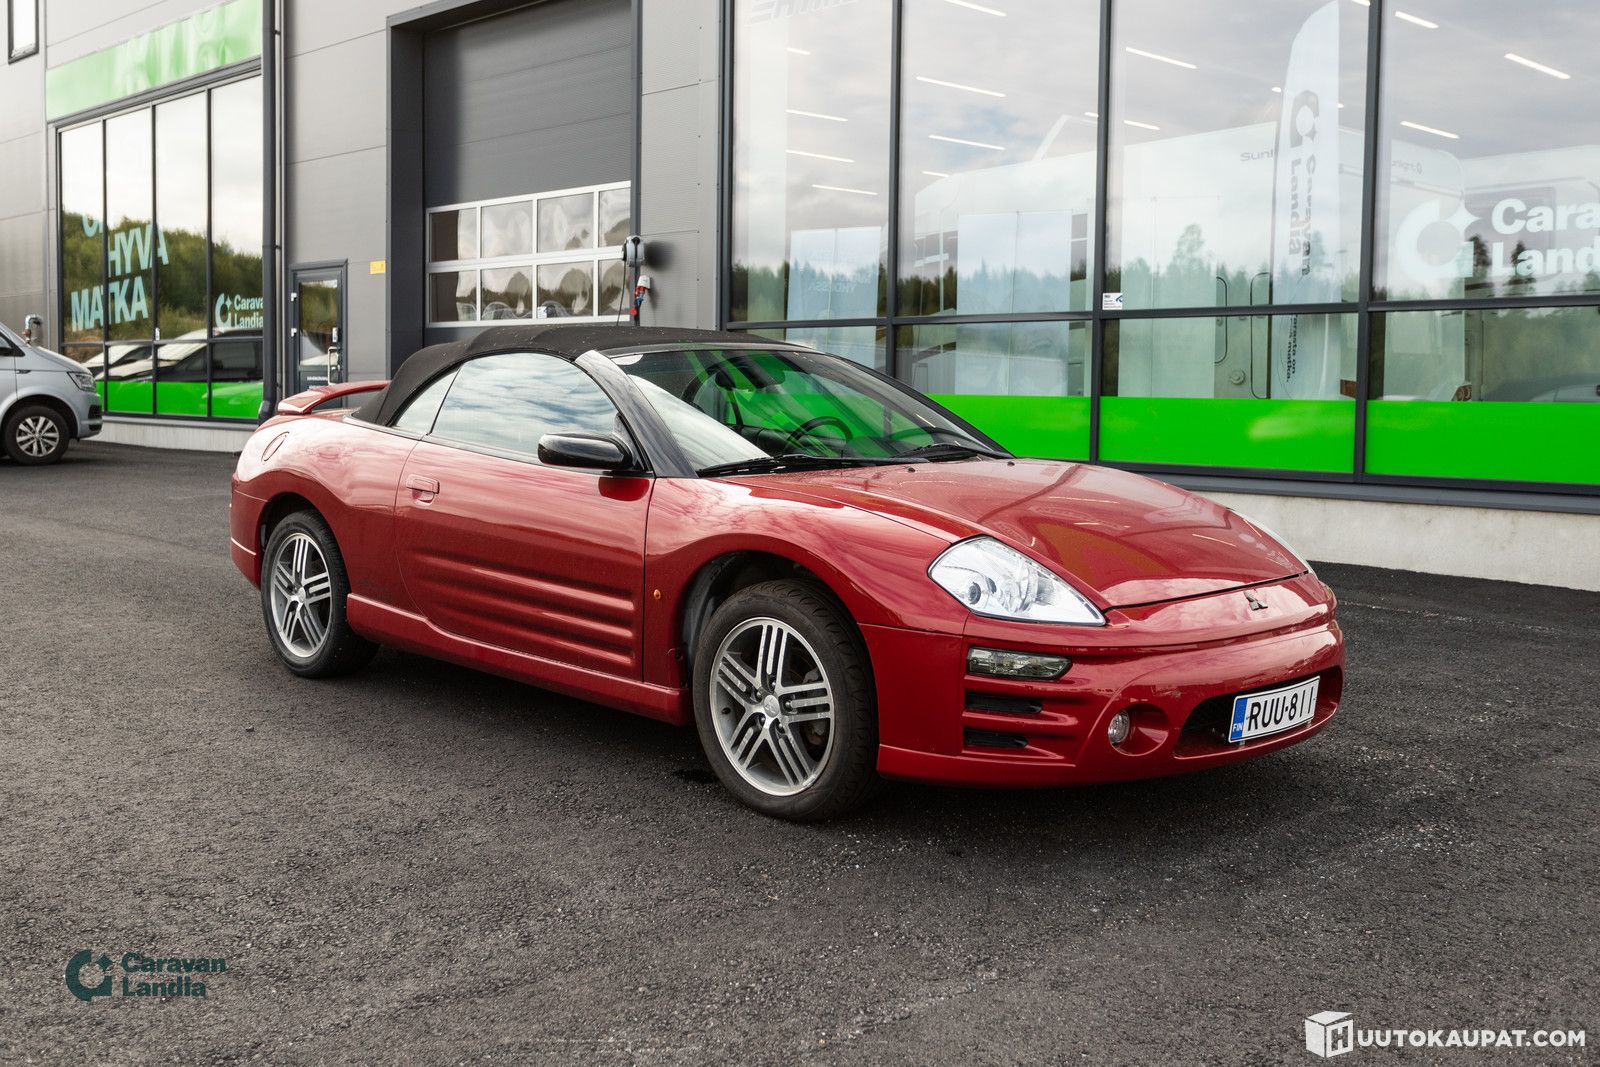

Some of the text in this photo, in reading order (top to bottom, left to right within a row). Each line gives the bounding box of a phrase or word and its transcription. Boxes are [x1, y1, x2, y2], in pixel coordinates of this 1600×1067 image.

[1289, 158, 1301, 255] Landia
[1491, 198, 1600, 235] Cara
[71, 275, 149, 332] MATKA
